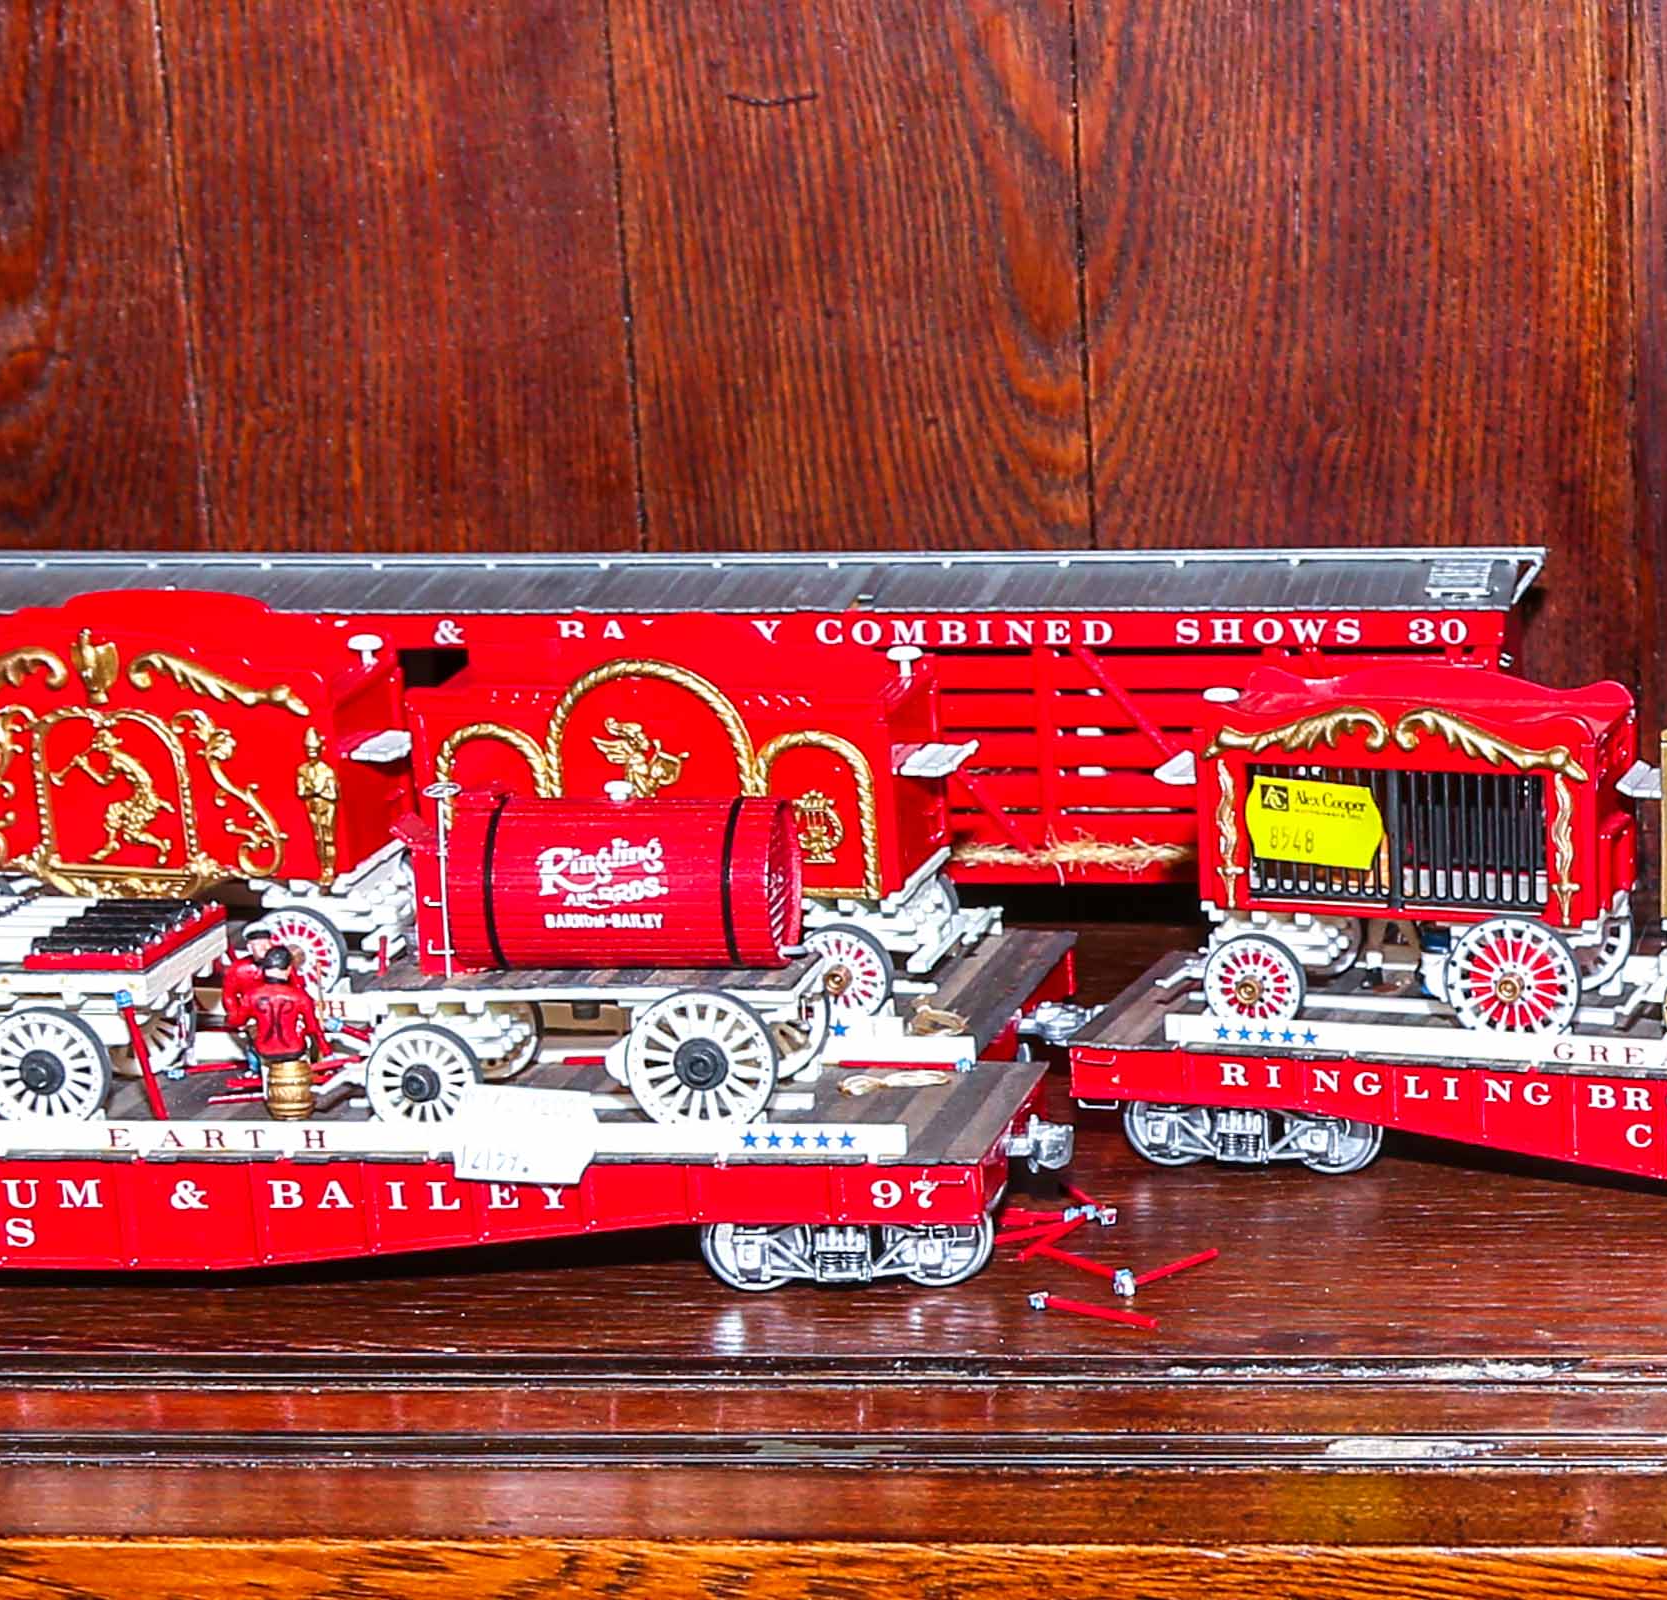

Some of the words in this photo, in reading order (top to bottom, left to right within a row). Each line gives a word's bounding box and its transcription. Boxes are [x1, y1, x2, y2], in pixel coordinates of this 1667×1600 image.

[434, 620, 464, 645] &
[816, 618, 1113, 646] COMBINED
[1176, 618, 1362, 645] SHOWS
[1408, 618, 1467, 645] 30
[1295, 790, 1319, 805] Alex
[1322, 792, 1366, 814] Cooper
[1270, 825, 1314, 854] 8548
[536, 837, 664, 896] Ringling
[597, 876, 669, 904] BROS.
[1221, 1063, 1550, 1105] RINGLING
[108, 1127, 328, 1148] EARTH
[170, 1180, 209, 1210] &
[268, 1180, 564, 1210] BAILEY
[870, 1180, 939, 1208] 97
